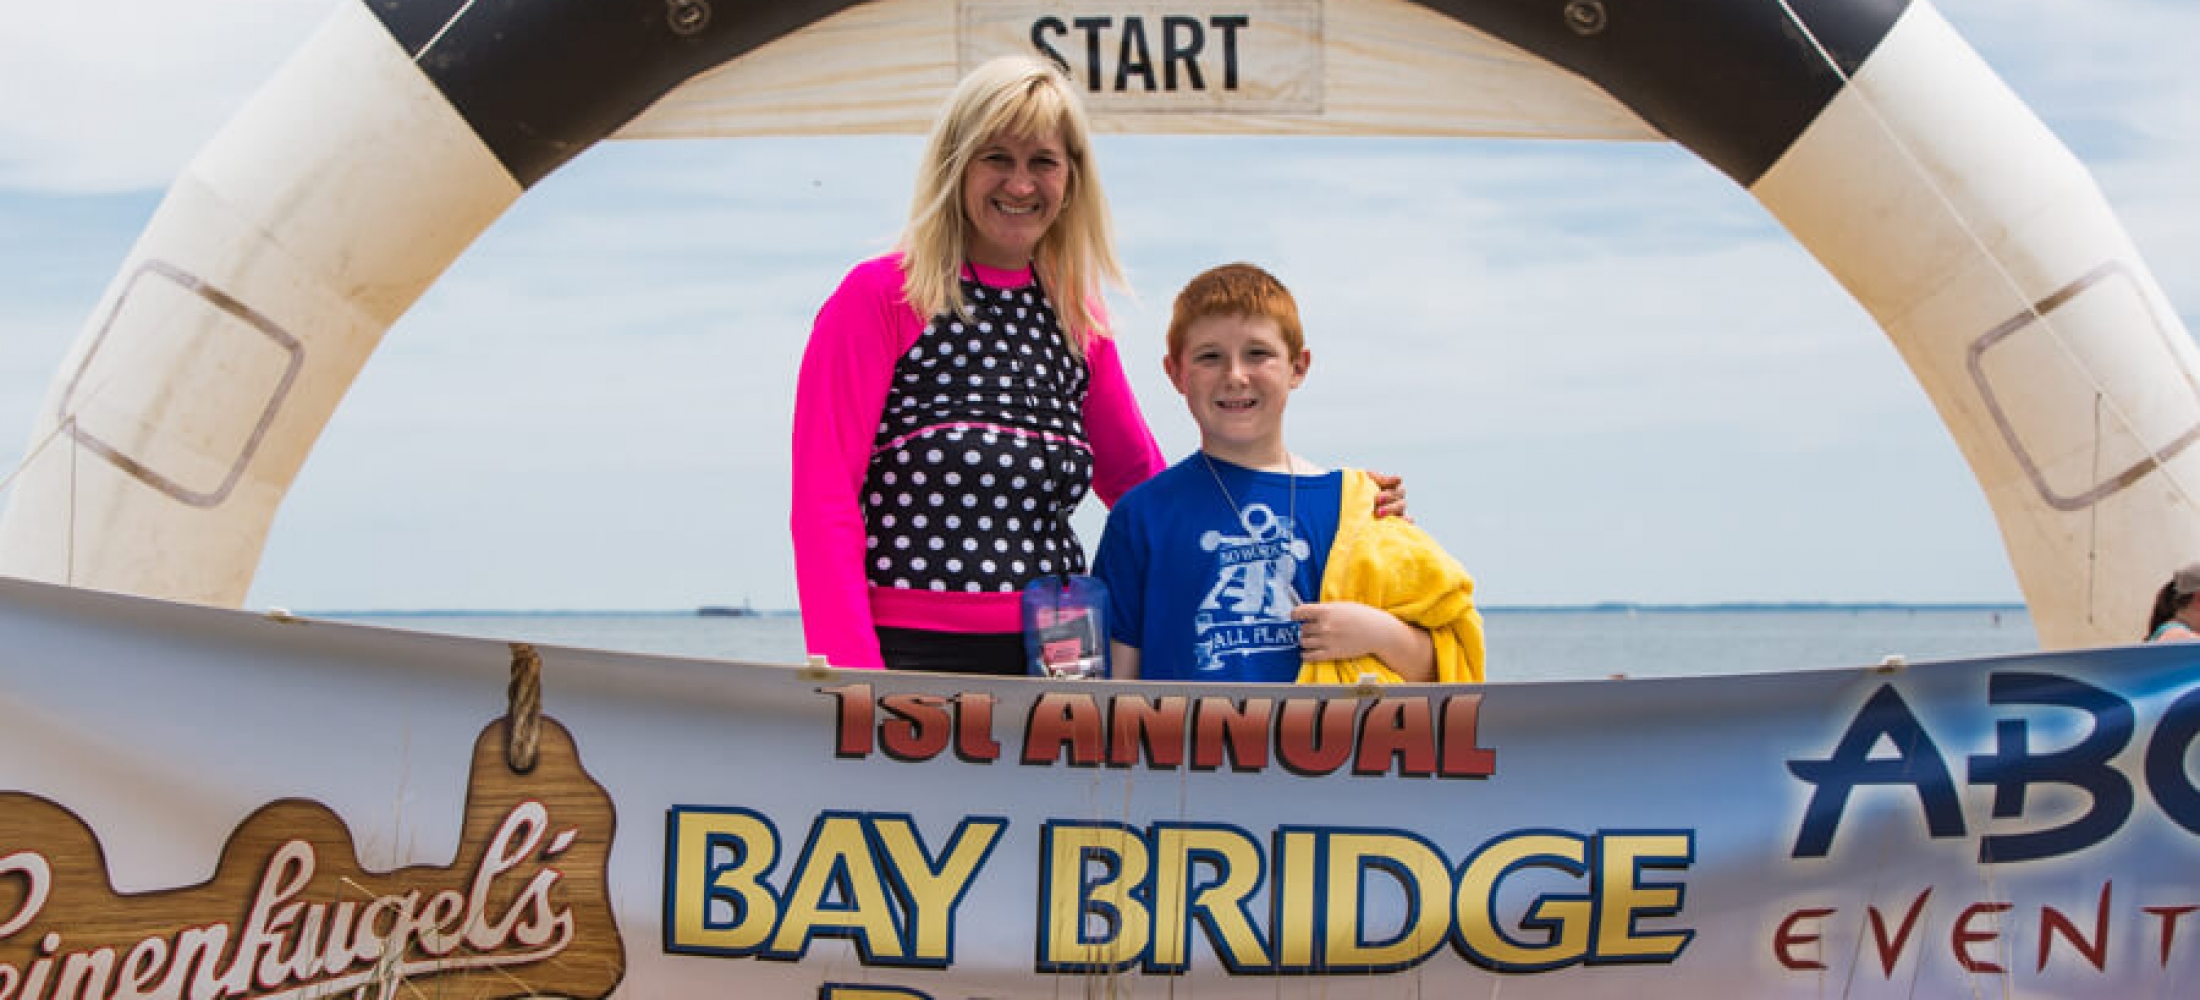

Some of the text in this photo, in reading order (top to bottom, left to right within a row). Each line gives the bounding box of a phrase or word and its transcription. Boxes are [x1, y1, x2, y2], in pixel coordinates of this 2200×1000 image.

[1031, 16, 1248, 92] START
[1213, 627, 1250, 648] ALL
[1020, 690, 1496, 780] ANNUAL
[663, 804, 1697, 975] BAY BRIDGE
